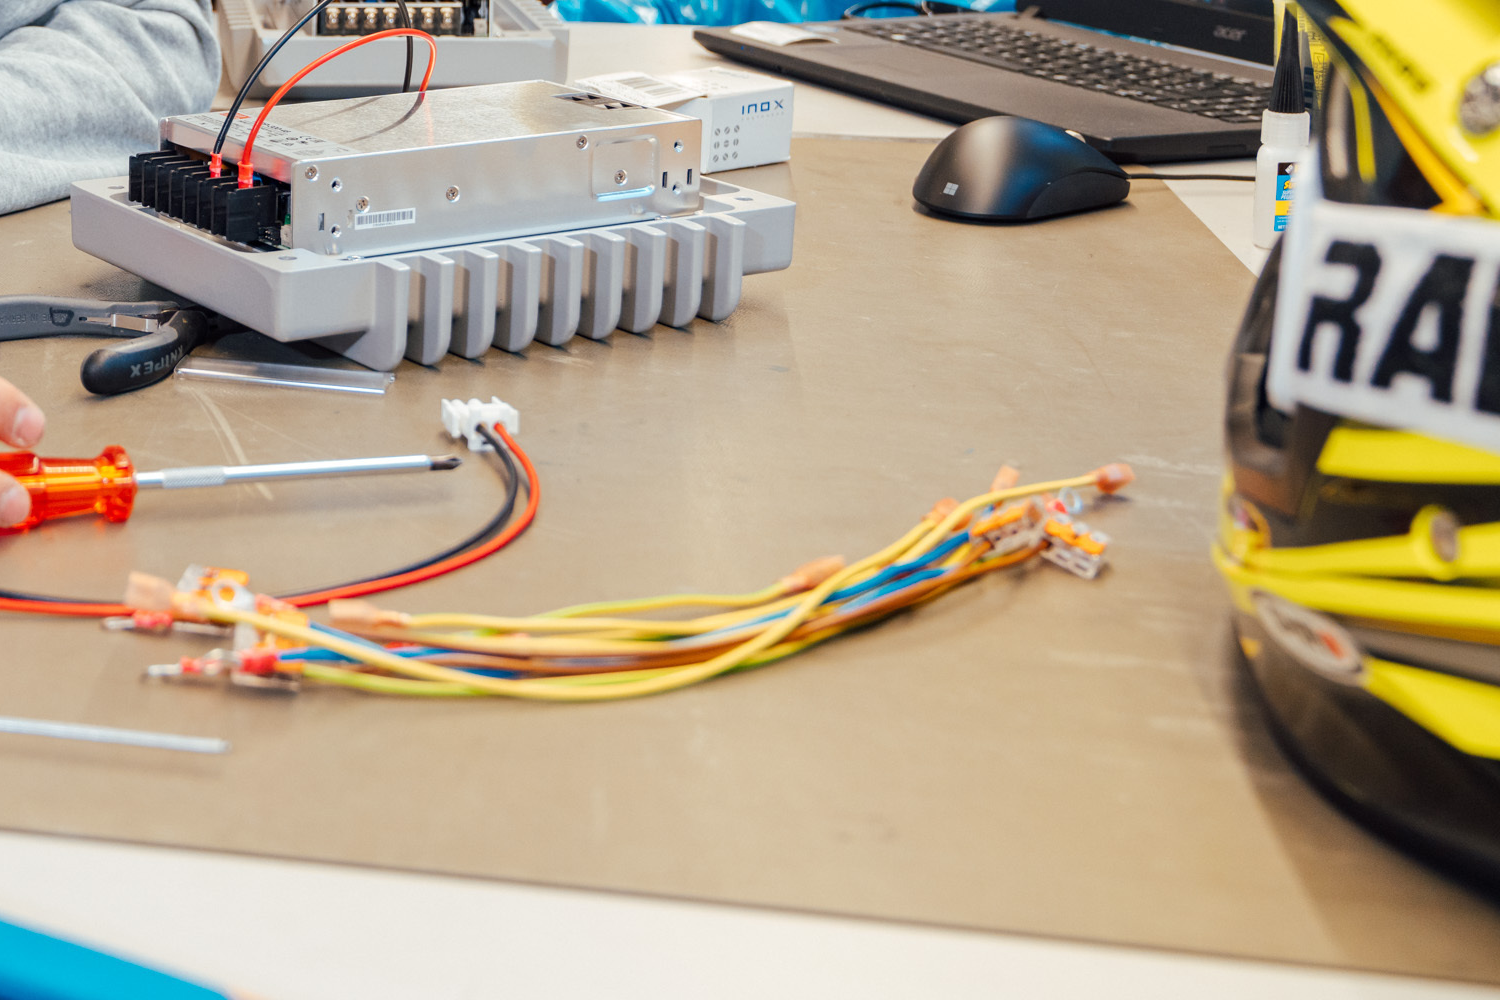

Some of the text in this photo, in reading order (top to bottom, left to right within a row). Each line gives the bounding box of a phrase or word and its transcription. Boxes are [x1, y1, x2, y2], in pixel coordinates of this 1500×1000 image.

[1213, 24, 1247, 41] acer
[1297, 239, 1500, 415] RA
[129, 344, 184, 379] KNIPEX
